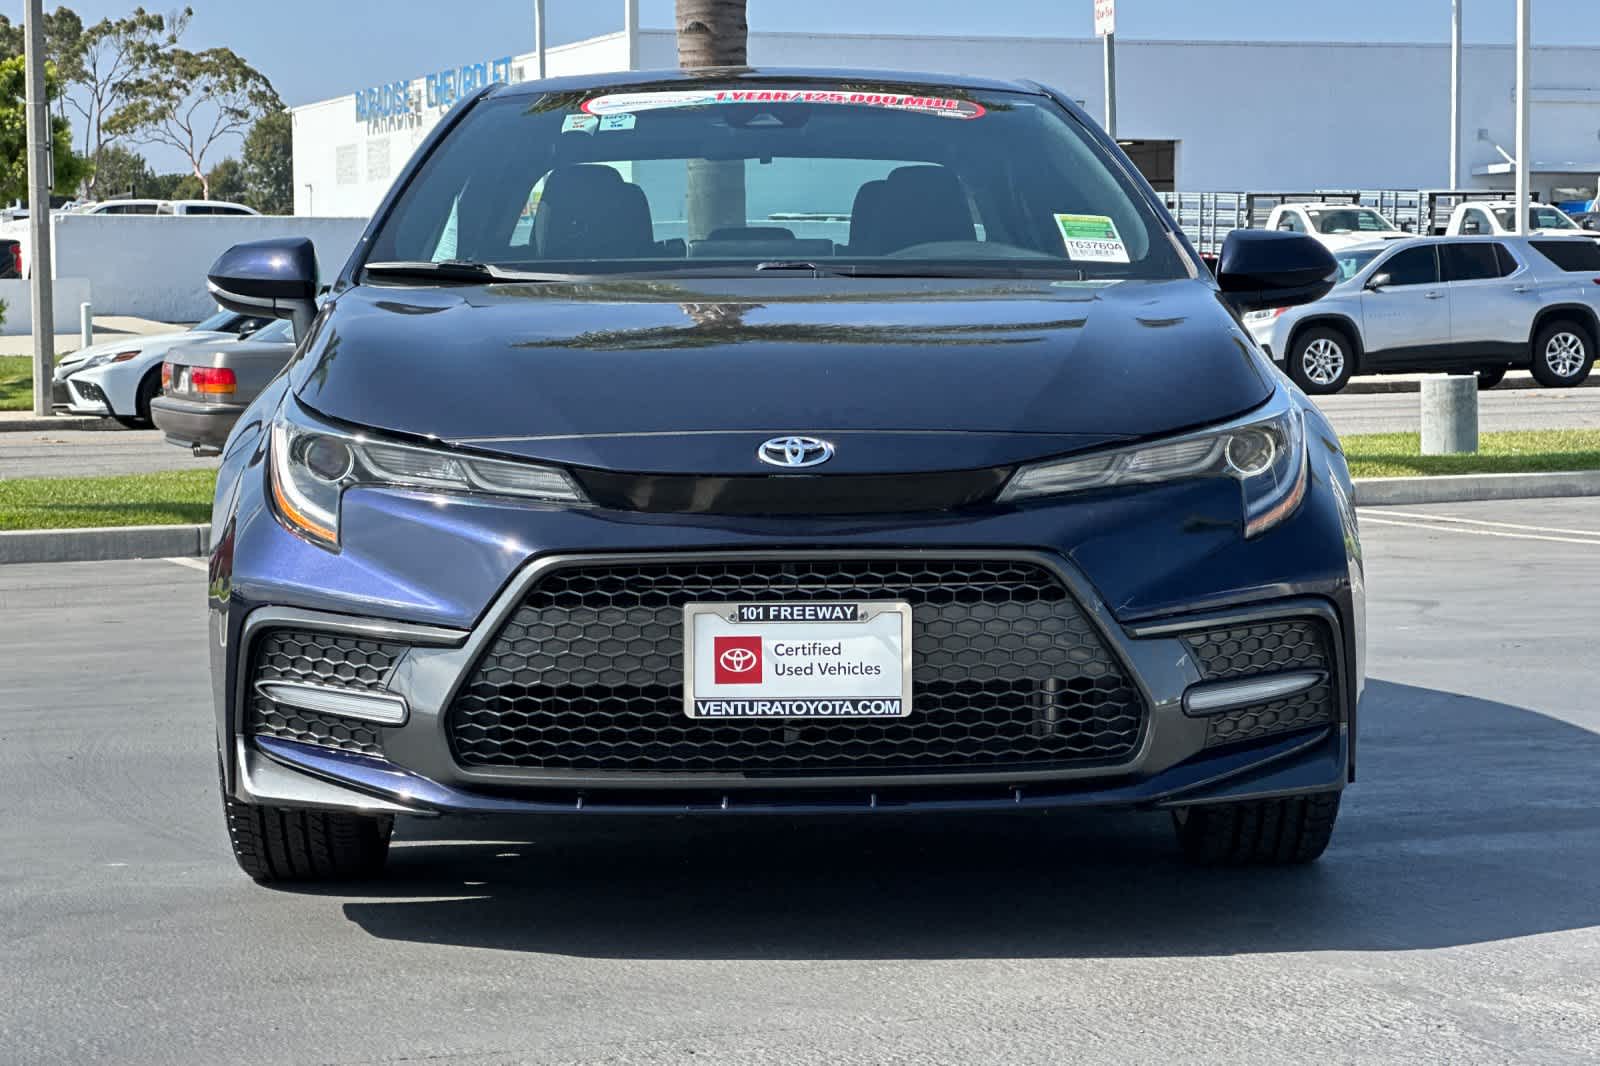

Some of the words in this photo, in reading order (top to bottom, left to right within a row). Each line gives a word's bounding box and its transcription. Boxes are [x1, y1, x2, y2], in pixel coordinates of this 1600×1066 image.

[355, 80, 410, 121] PARADISE
[425, 56, 512, 108] CHEVROLET
[902, 96, 958, 109] MILE
[741, 606, 764, 620] 101
[769, 606, 855, 620] FREEWAY
[774, 642, 842, 657] Certified
[774, 662, 814, 676] Used
[817, 662, 881, 676] Vehicles
[697, 700, 900, 716] VENTURATOYOTA.COM
